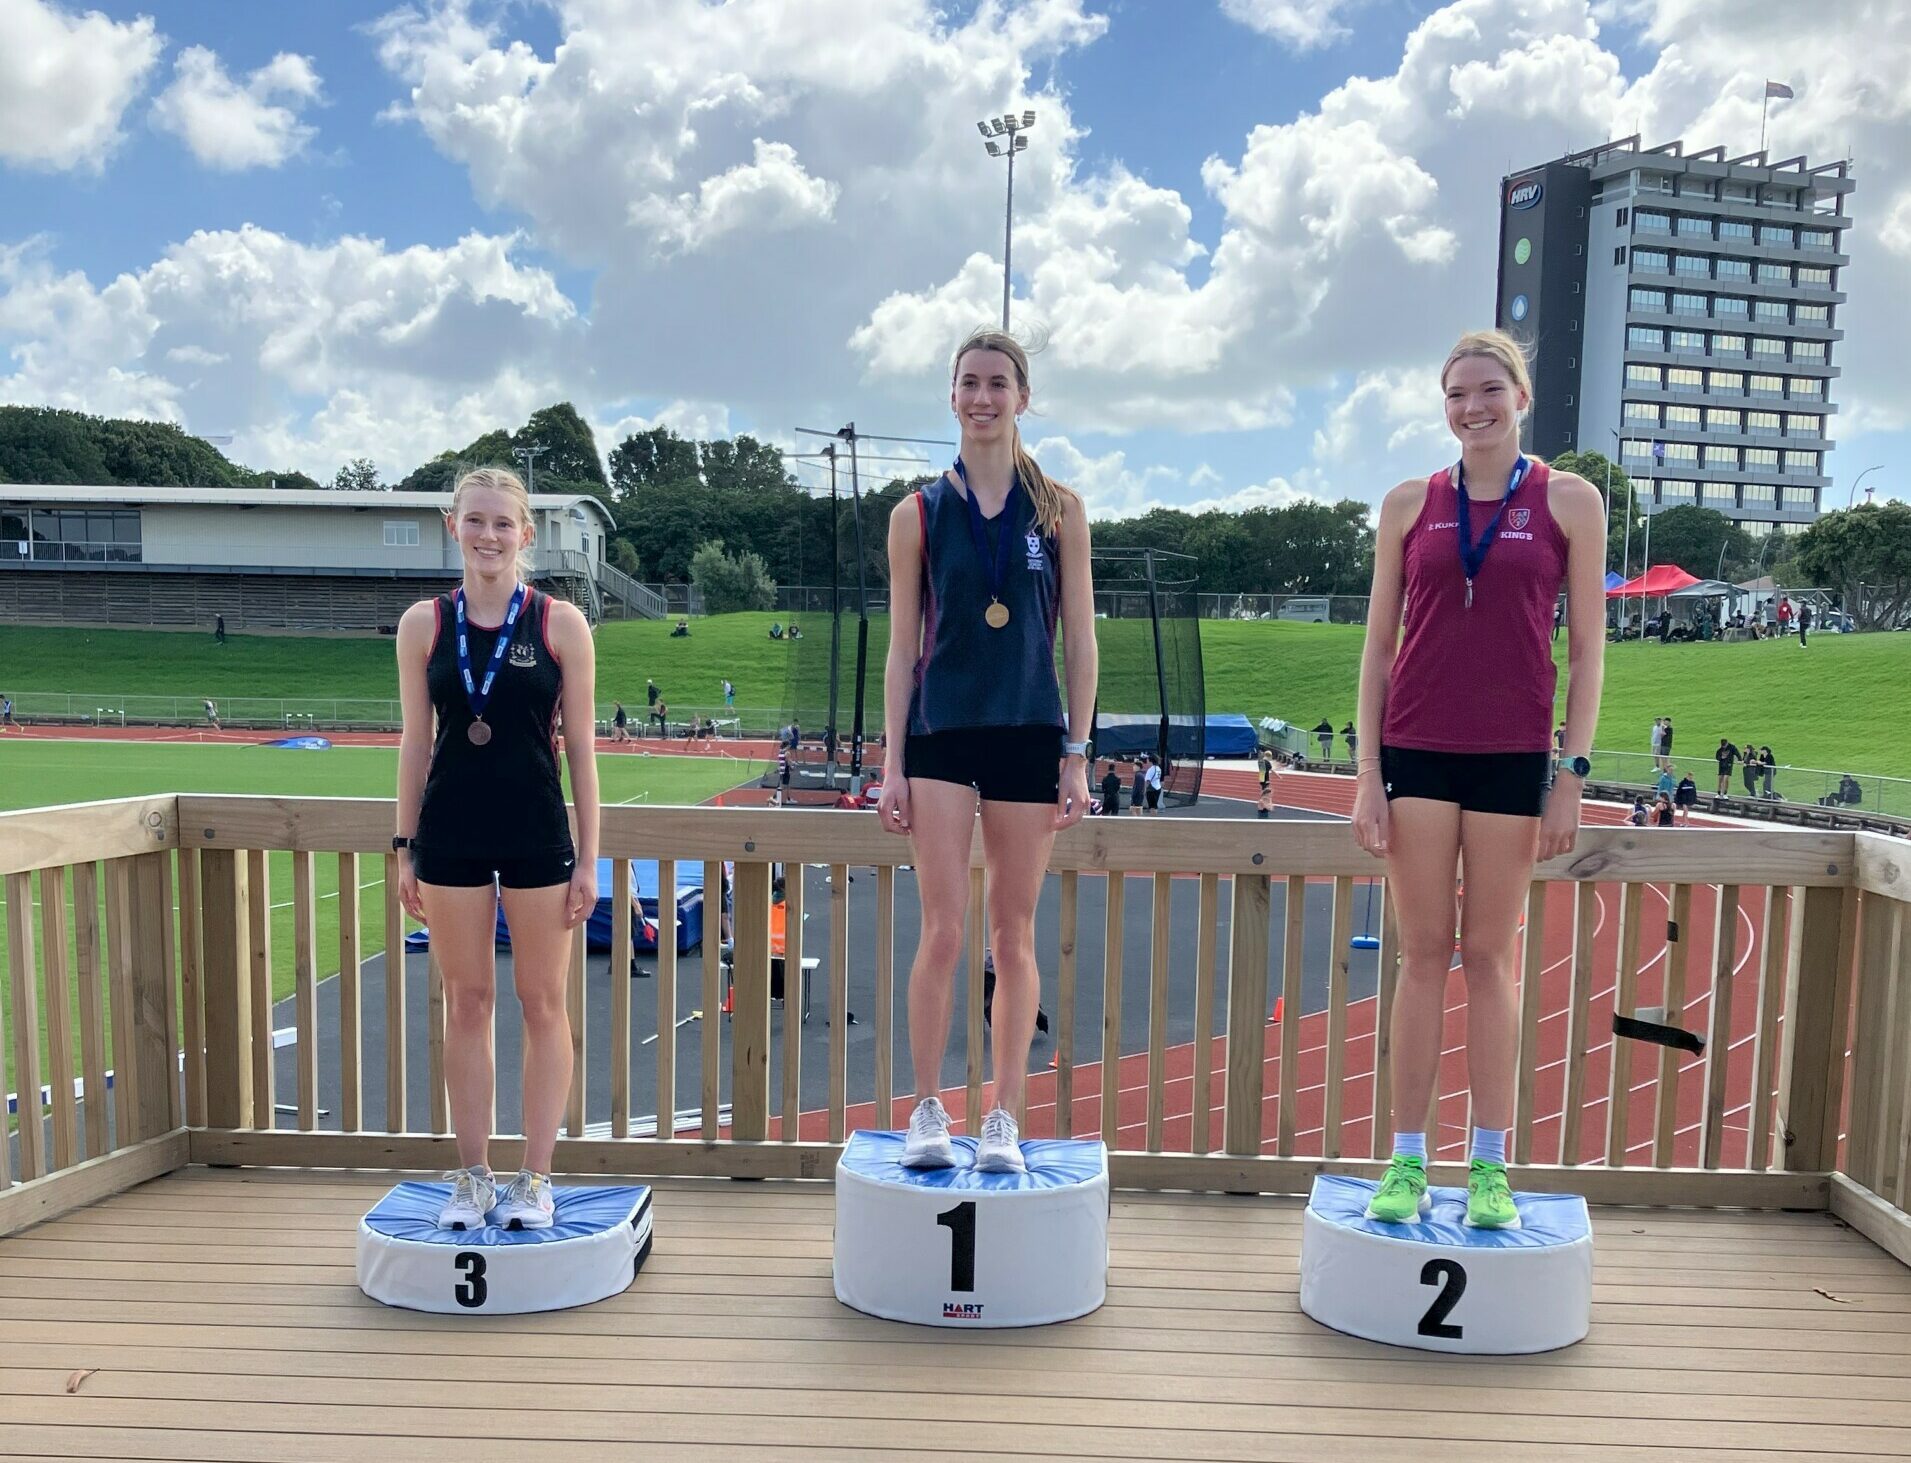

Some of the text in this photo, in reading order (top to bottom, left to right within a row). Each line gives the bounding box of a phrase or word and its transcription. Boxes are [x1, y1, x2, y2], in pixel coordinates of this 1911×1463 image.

[1510, 184, 1538, 205] HRV
[1500, 531, 1533, 541] KING'S
[936, 1201, 976, 1292] 1
[454, 1251, 488, 1308] 3
[1417, 1258, 1467, 1339] 2
[943, 1303, 984, 1313] HART
